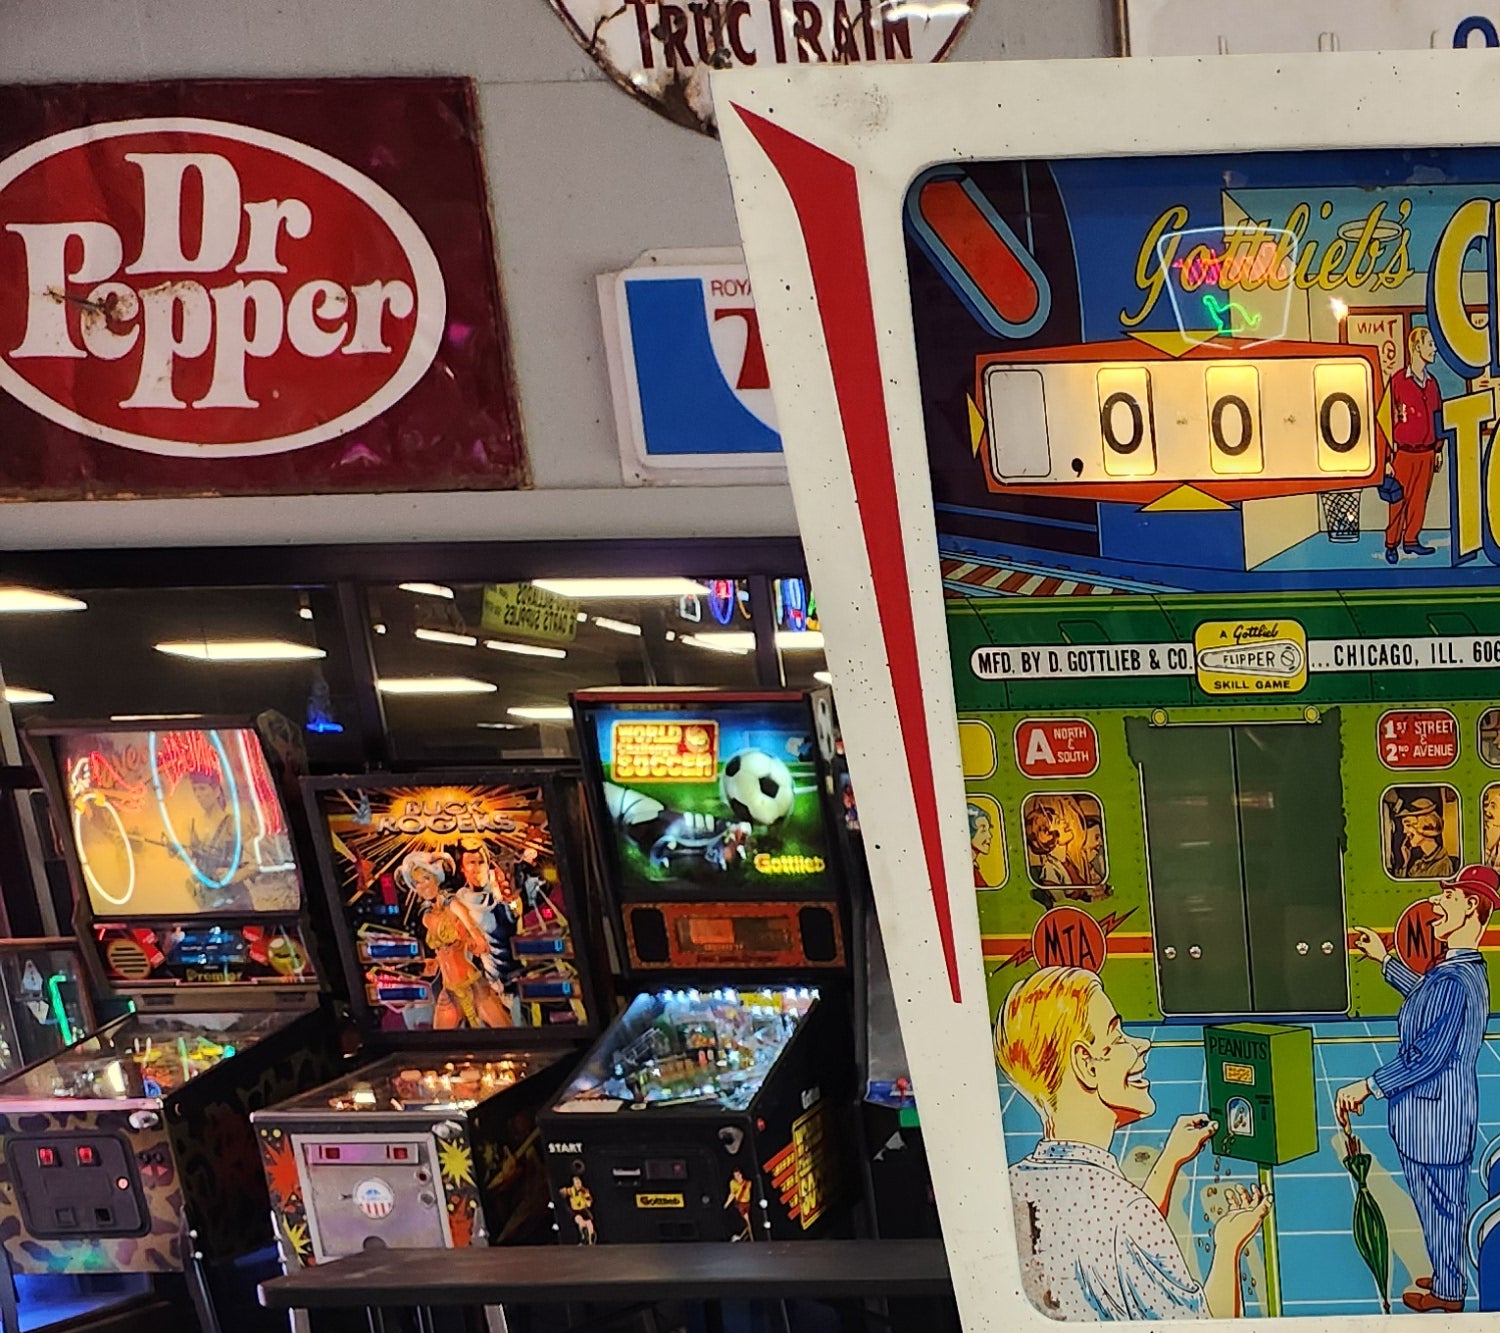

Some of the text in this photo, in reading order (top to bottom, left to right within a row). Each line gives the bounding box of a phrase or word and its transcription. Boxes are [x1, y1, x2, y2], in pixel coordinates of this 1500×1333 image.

[125, 153, 311, 274] Dr
[1120, 199, 1415, 326] Gottlieb's
[6, 221, 414, 409] Pepper
[978, 648, 1194, 675] MFD. BY D. GOTTLIEB & CO.
[1223, 650, 1276, 667] FLIPPER
[1431, 642, 1464, 664] ILL.
[1214, 680, 1290, 690] SKILL GAME
[1054, 726, 1087, 740] NORTH
[1414, 719, 1454, 735] STREET
[1026, 728, 1057, 766] A
[1057, 750, 1089, 763] SOUTH
[1413, 743, 1454, 758] AVENUE
[405, 800, 486, 817] BUCK
[377, 811, 516, 835] ROGERS
[1044, 917, 1097, 970] MTA
[1208, 1035, 1268, 1060] PEANUTS
[548, 1142, 582, 1153] START
